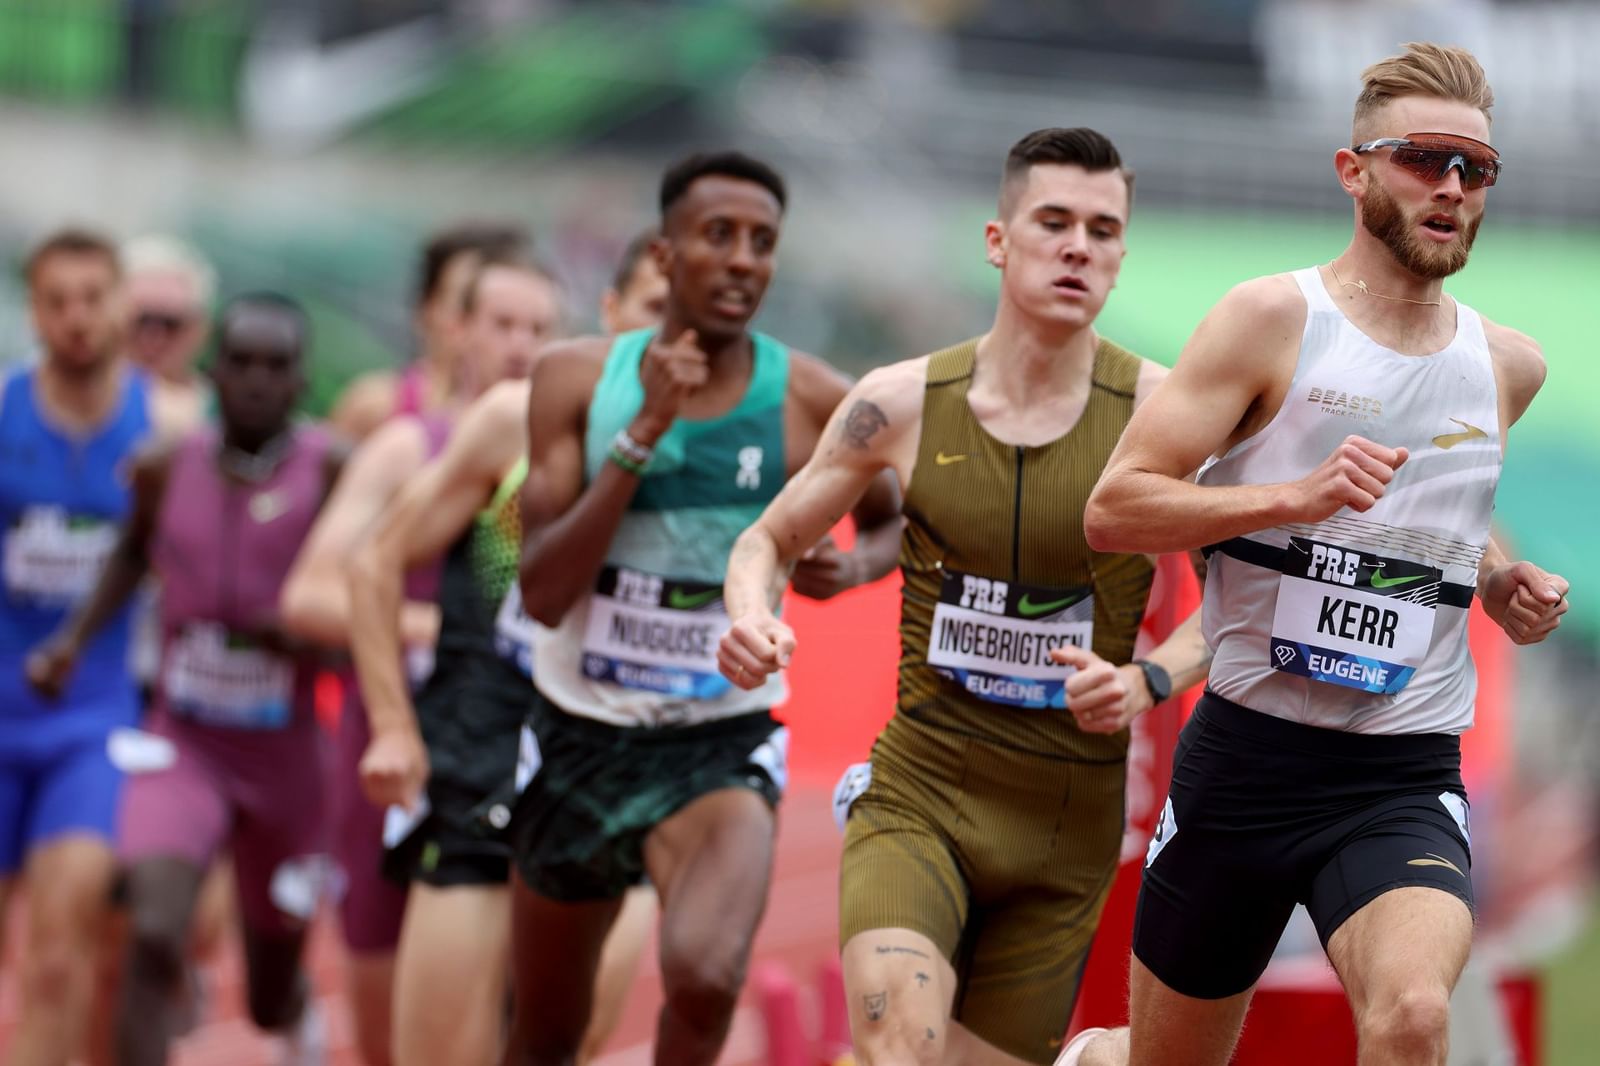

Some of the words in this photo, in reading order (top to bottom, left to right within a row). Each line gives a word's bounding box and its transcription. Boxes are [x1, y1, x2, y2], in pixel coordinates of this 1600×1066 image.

[1320, 406, 1346, 417] TRACK
[1307, 543, 1361, 587] PRE
[959, 574, 1009, 616] PRE
[608, 612, 711, 658] NUGUSE
[1316, 595, 1400, 649] KERR
[965, 674, 1047, 701] EUGENE
[1307, 653, 1389, 688] EUGENE
